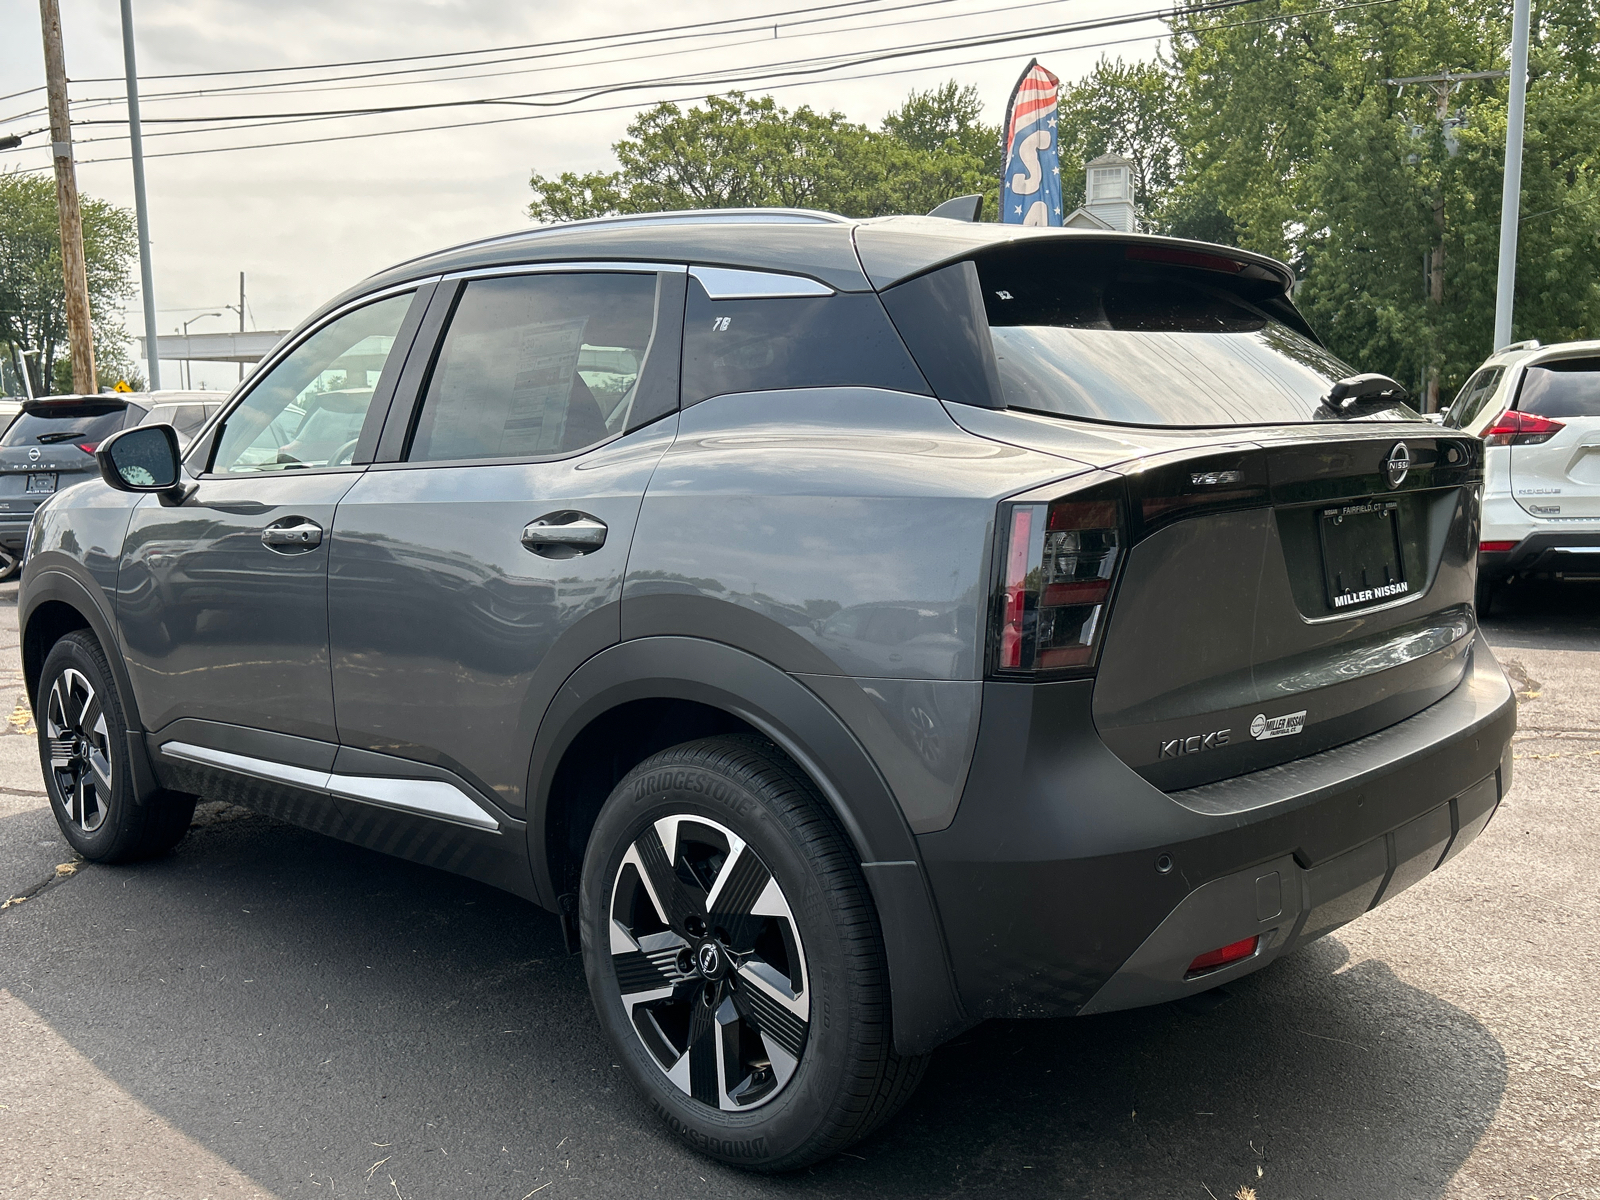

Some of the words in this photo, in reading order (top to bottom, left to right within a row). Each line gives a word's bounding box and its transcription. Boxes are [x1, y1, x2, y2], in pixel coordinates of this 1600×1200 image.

[1342, 504, 1371, 515] FAIRFIELD
[1373, 503, 1382, 511] CT
[1334, 590, 1373, 607] MILLER
[1374, 582, 1408, 598] NISSAN
[1265, 718, 1286, 731] MILLER
[1286, 715, 1306, 729] NISSAN
[1159, 728, 1231, 759] KICKS
[634, 771, 754, 818] BRIDGESTONE
[650, 1097, 770, 1159] BRIDGESTONE
